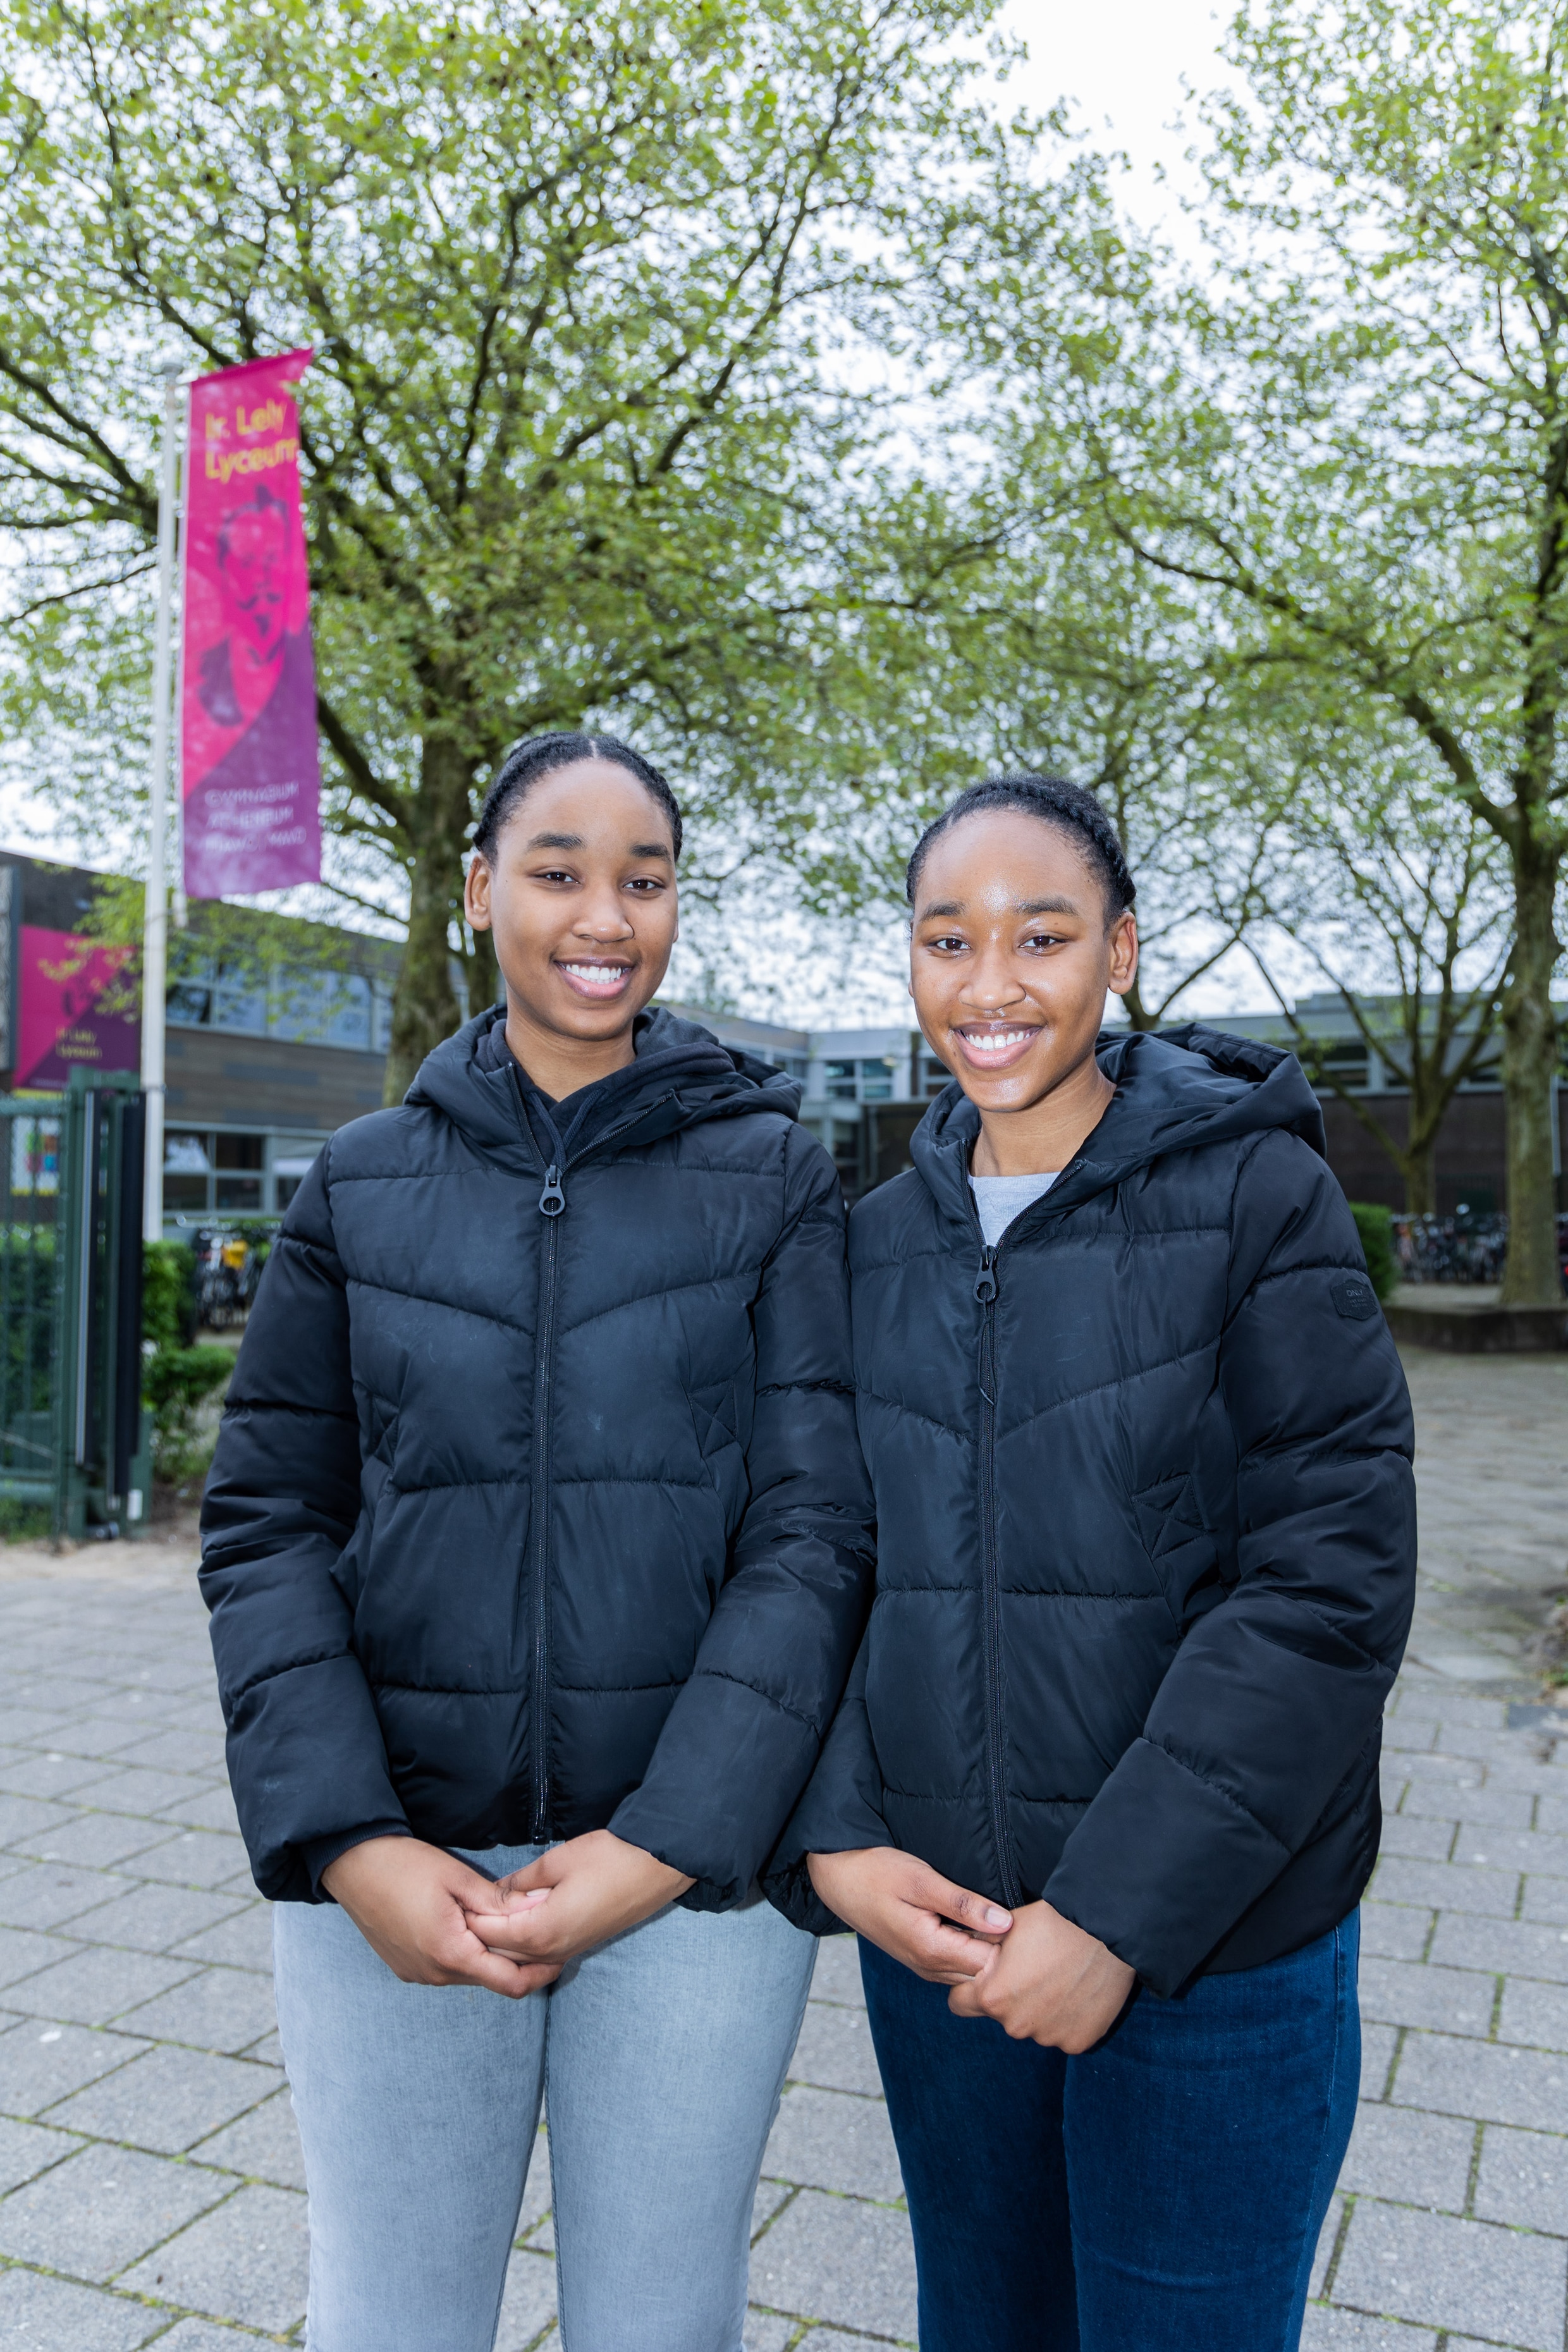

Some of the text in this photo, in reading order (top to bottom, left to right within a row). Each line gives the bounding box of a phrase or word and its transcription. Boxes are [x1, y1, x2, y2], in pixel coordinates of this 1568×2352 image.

[236, 398, 288, 436] Lely
[205, 437, 298, 484] Lyceum
[56, 1043, 102, 1059] Lyceum
